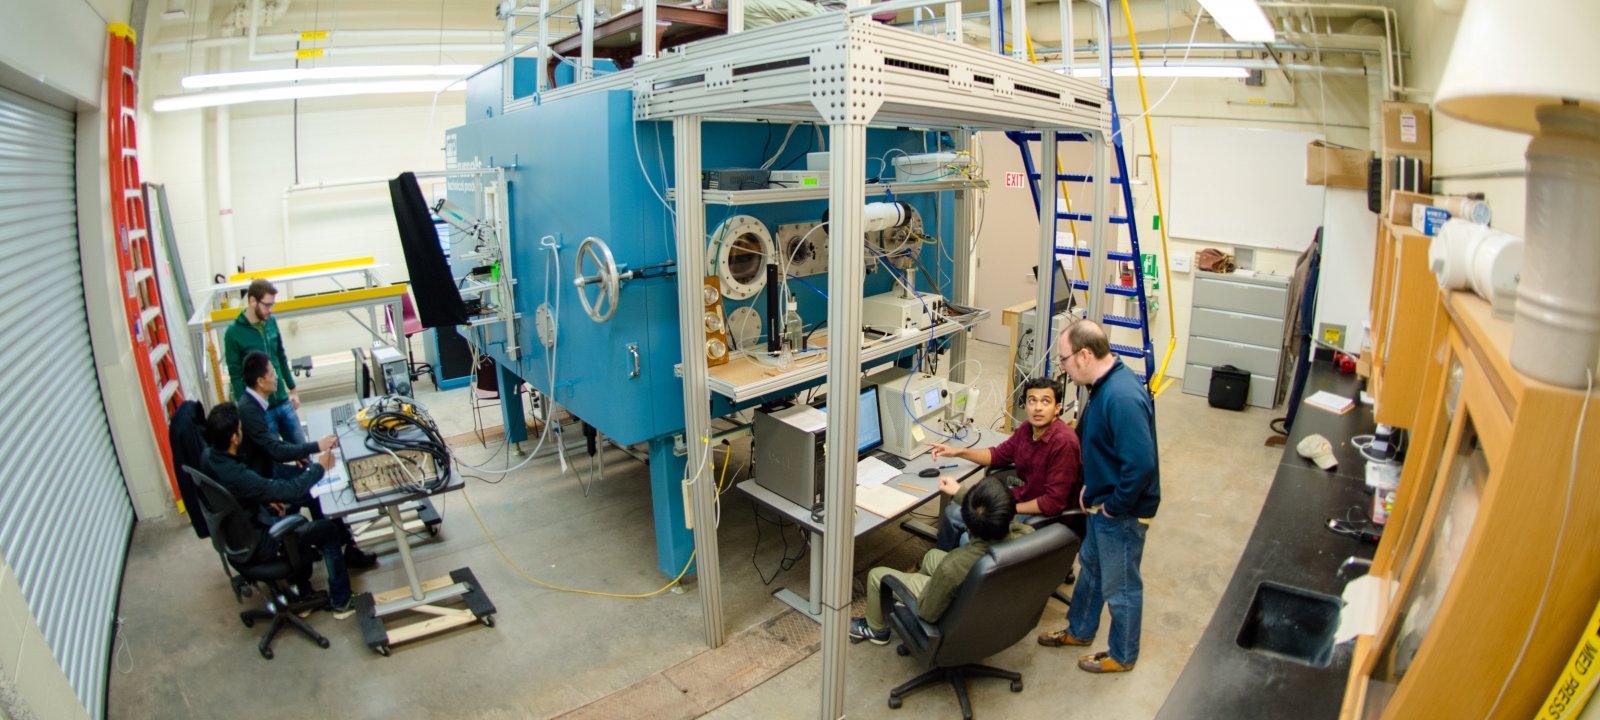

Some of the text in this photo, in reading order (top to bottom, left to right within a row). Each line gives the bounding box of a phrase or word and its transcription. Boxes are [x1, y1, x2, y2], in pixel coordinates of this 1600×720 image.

[1006, 173, 1024, 187] EXIT
[1548, 640, 1598, 720] MED PRESS
